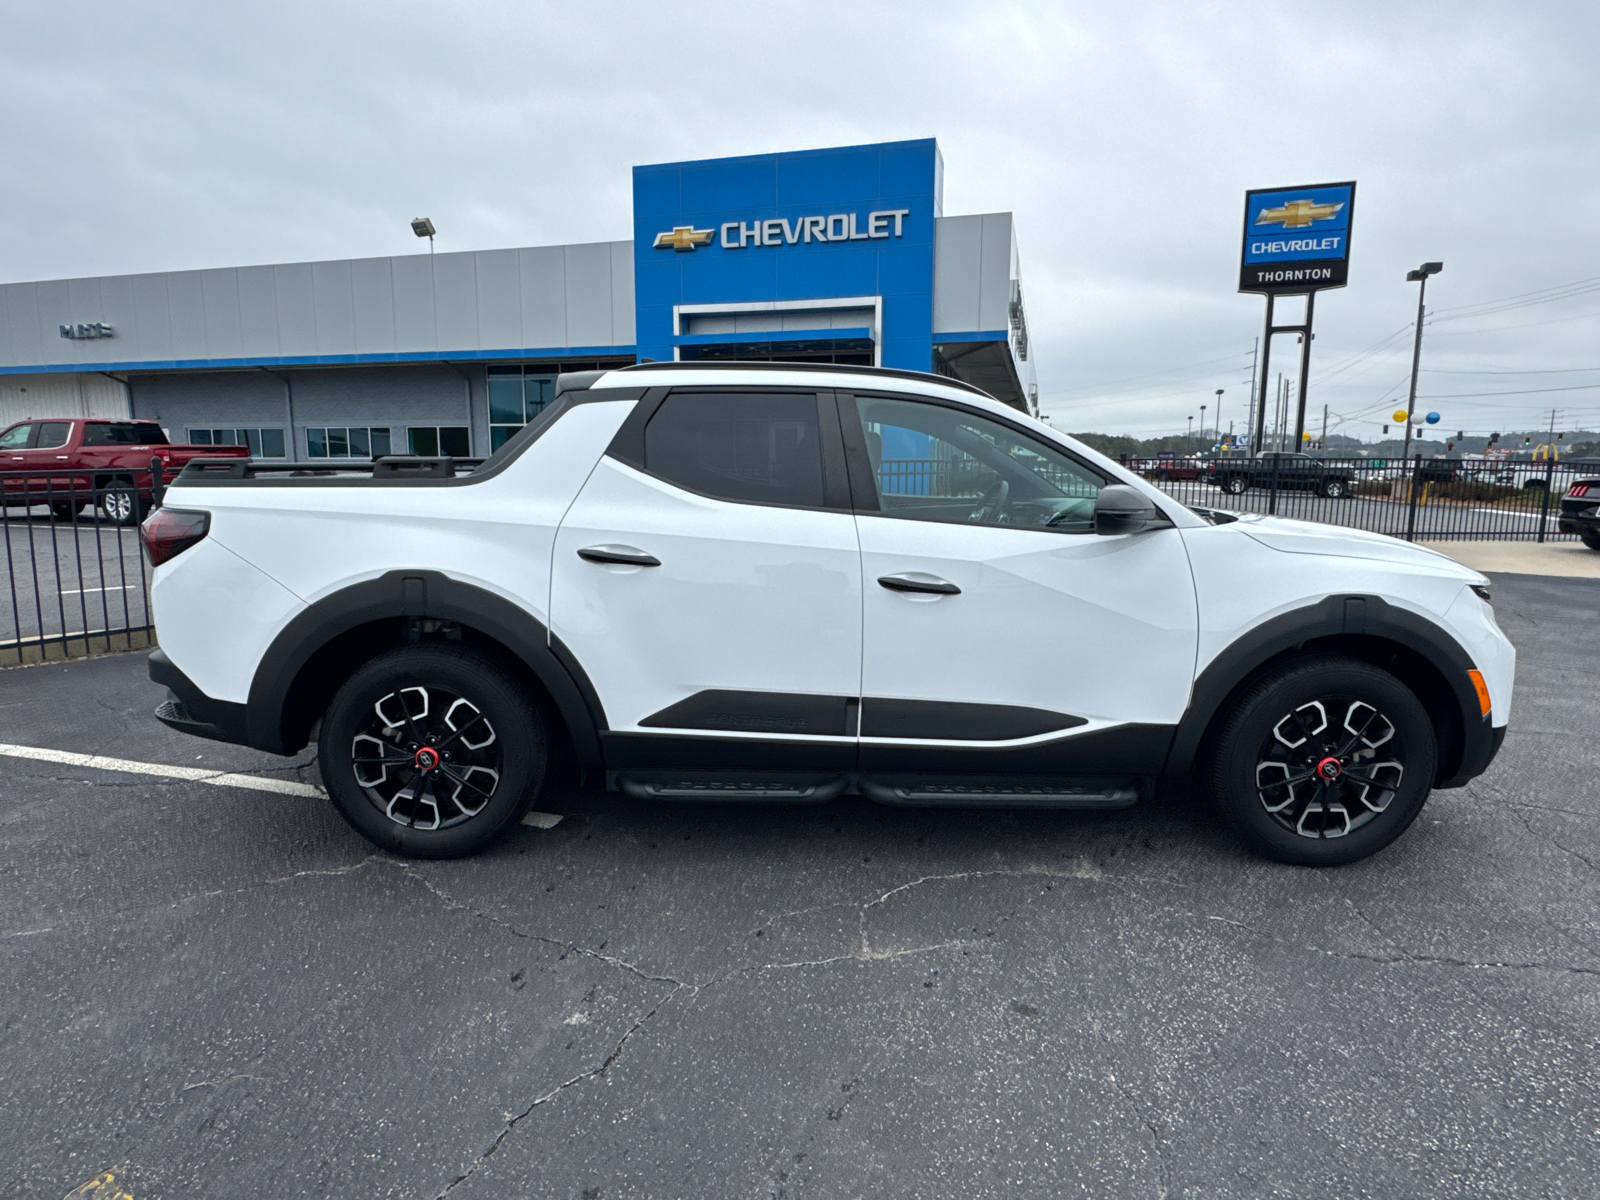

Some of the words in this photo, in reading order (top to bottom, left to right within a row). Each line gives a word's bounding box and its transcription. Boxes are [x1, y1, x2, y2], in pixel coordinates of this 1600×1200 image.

[720, 209, 909, 248] CHEVROLET
[1251, 237, 1341, 254] CHEVROLET
[1257, 268, 1331, 282] THORNTON
[59, 322, 112, 339] PARTS
[707, 713, 762, 726] SANTA
[764, 715, 809, 729] CRUZ
